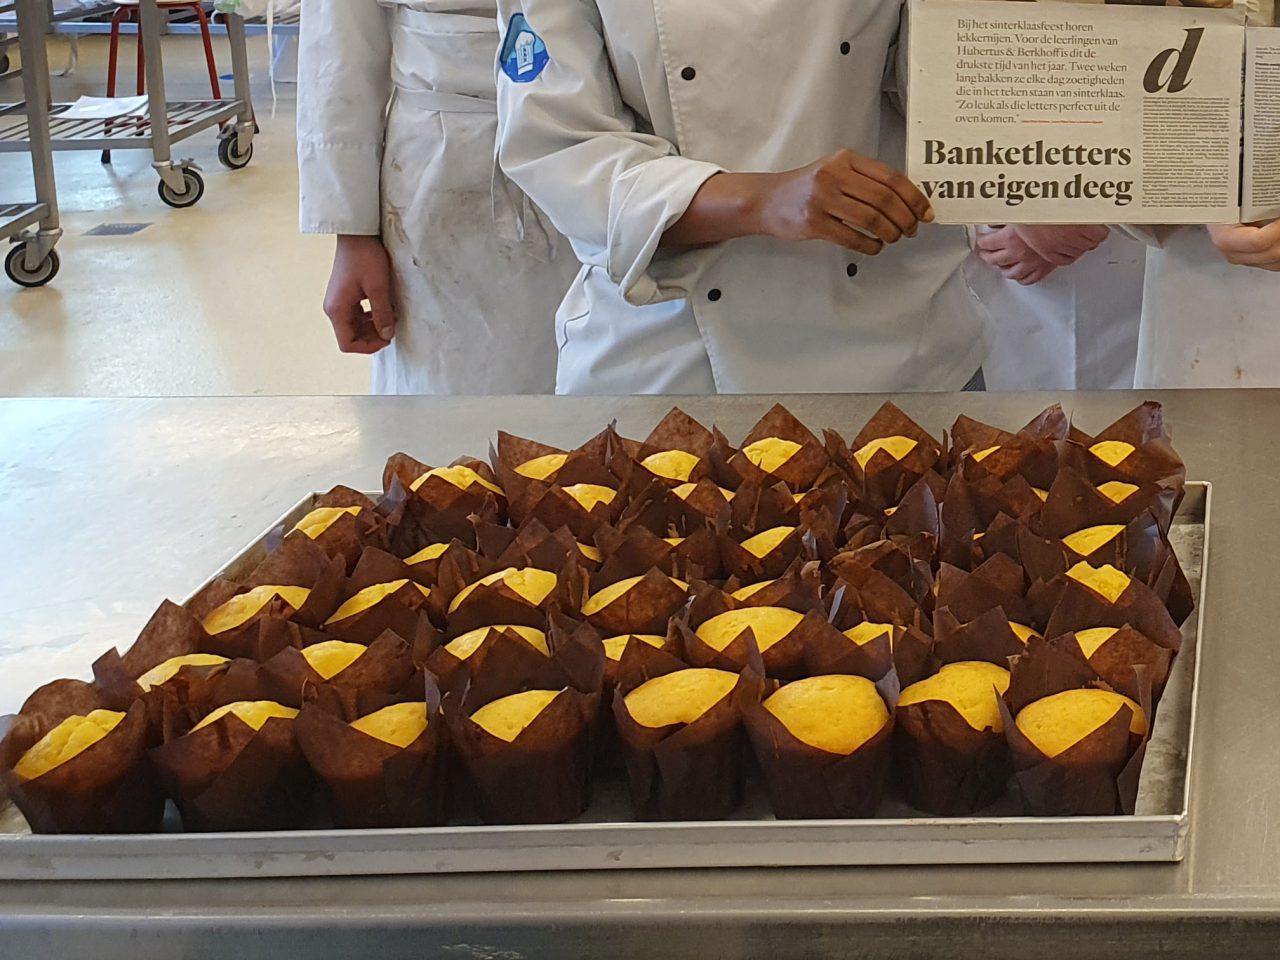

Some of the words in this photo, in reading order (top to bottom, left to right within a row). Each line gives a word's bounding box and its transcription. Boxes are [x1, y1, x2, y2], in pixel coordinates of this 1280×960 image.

[958, 19, 971, 31] Bij
[973, 20, 988, 30] het
[990, 20, 1064, 31] sinterklaasfeest
[1065, 22, 1093, 31] horen
[957, 32, 1012, 45] lekkernijen.
[1015, 34, 1039, 43] Voor
[1040, 35, 1052, 44] de
[1053, 36, 1100, 47] leerlingen
[957, 46, 1005, 56] Hubertus
[1006, 47, 1015, 56] &
[1017, 47, 1061, 57] Berkhoff
[1061, 49, 1068, 57] is
[1069, 49, 1083, 58] dit
[1084, 49, 1096, 58] de
[956, 60, 994, 69] drukste
[995, 60, 1011, 72] tijd
[1013, 62, 1029, 70] van
[1031, 61, 1046, 70] het
[1048, 62, 1067, 72] jaar.
[1069, 62, 1099, 71] Twee
[1097, 62, 1127, 72] weken
[1142, 27, 1205, 94] d
[956, 73, 976, 85] lang
[978, 74, 1012, 83] bakken
[1014, 75, 1025, 83] ze
[1027, 74, 1046, 84] elke
[1047, 74, 1065, 86] dag
[1066, 75, 1125, 87] zoetigheden
[956, 87, 972, 96] die
[973, 87, 982, 95] in
[983, 87, 1000, 96] het
[1001, 88, 1029, 97] teken
[1029, 89, 1055, 97] staan
[1073, 89, 1125, 98] sinterklaas.
[975, 100, 995, 109] leuk
[996, 100, 1009, 110] als
[1010, 101, 1026, 110] die
[1027, 101, 1058, 111] letters
[1059, 101, 1093, 112] perfect
[1094, 102, 1107, 111] uit
[1108, 102, 1120, 112] de
[955, 115, 980, 123] oven
[923, 139, 1132, 166] Banketletters
[920, 179, 975, 199] van
[979, 173, 1060, 206] eigen
[1063, 173, 1134, 206] deeg
